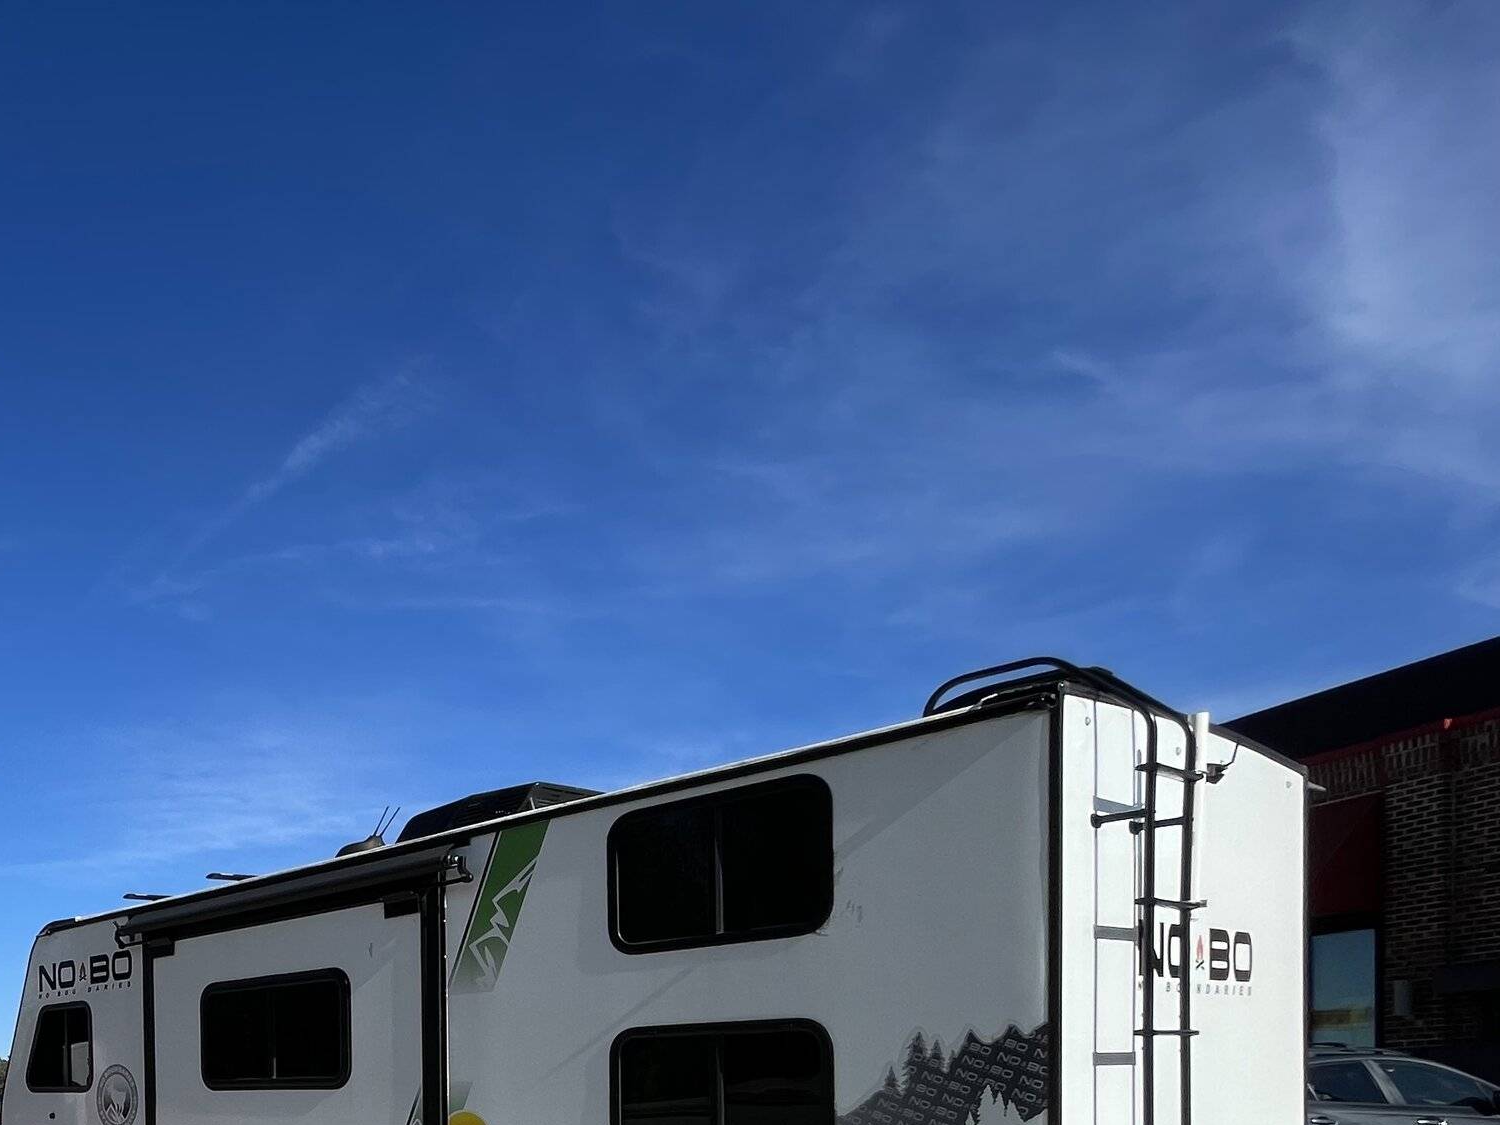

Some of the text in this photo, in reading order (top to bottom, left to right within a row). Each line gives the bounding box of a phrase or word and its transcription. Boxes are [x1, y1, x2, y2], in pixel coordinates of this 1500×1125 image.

[39, 950, 132, 992] NO BO
[1209, 928, 1252, 982] BO
